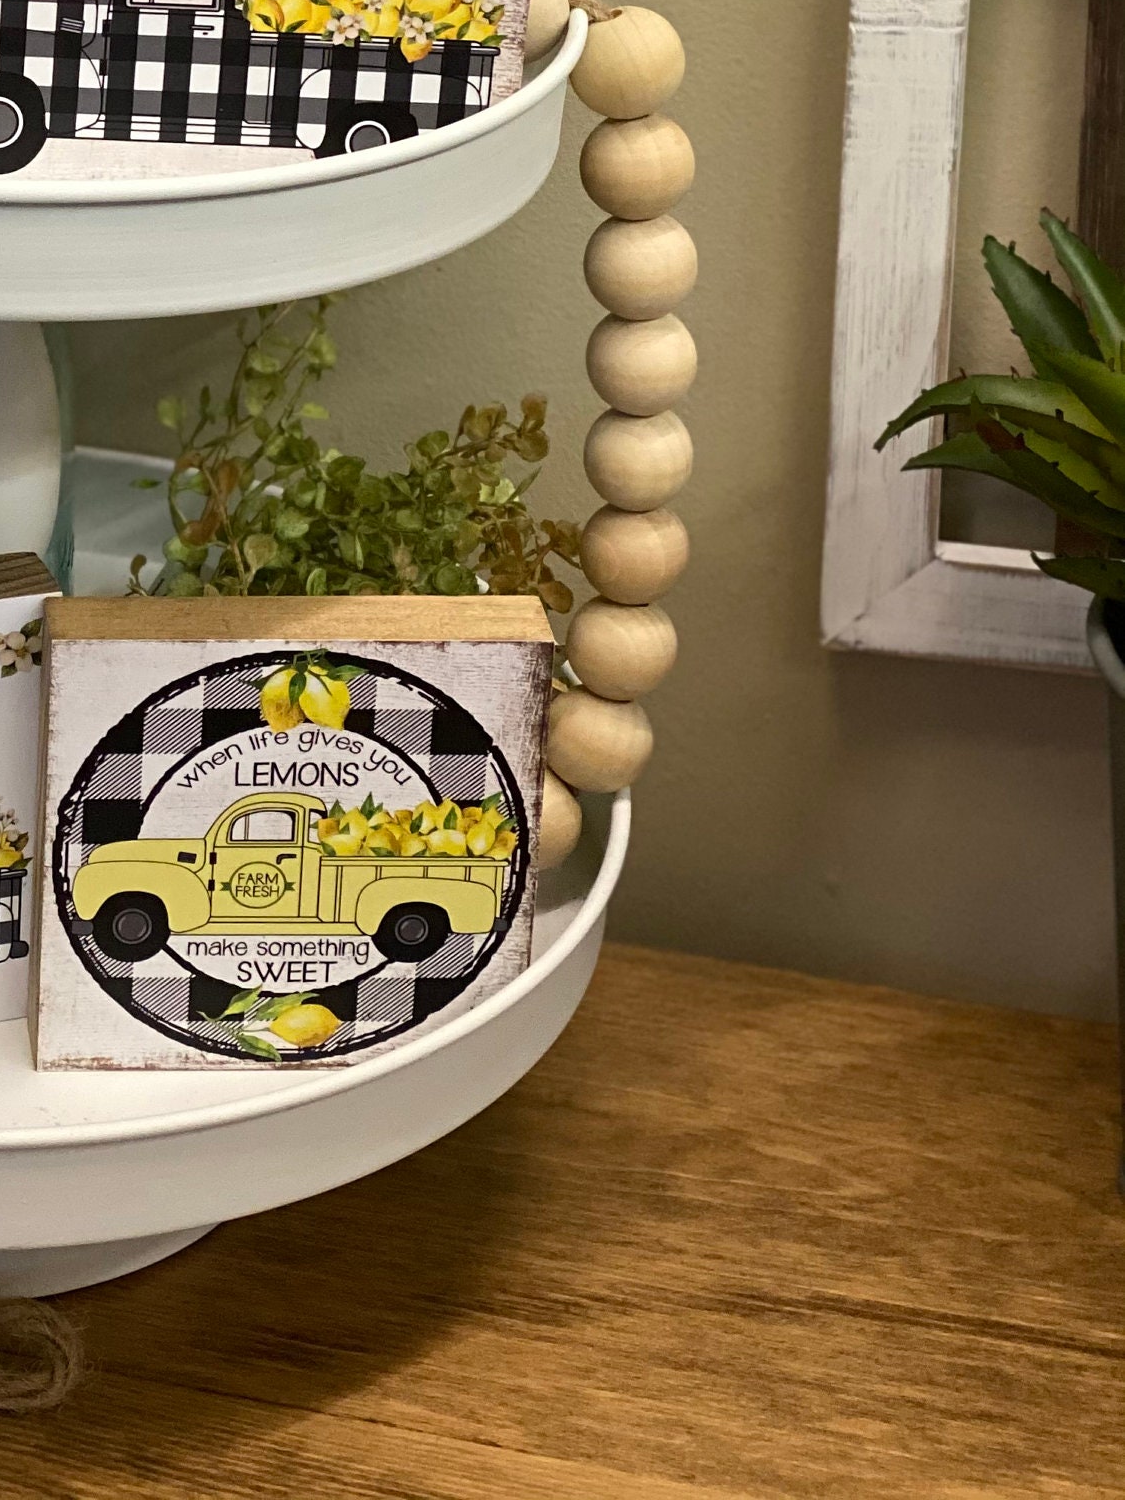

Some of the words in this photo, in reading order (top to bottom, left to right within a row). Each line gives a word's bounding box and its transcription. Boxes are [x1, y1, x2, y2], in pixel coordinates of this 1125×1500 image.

[177, 743, 243, 790] when
[249, 730, 289, 750] life
[298, 728, 364, 755] gives
[363, 749, 413, 786] you
[234, 761, 360, 787] LEMONS
[237, 872, 279, 885] FARM
[235, 885, 280, 898] FRESH
[187, 938, 248, 957] make
[256, 938, 370, 965] something
[237, 961, 338, 983] SWEET
